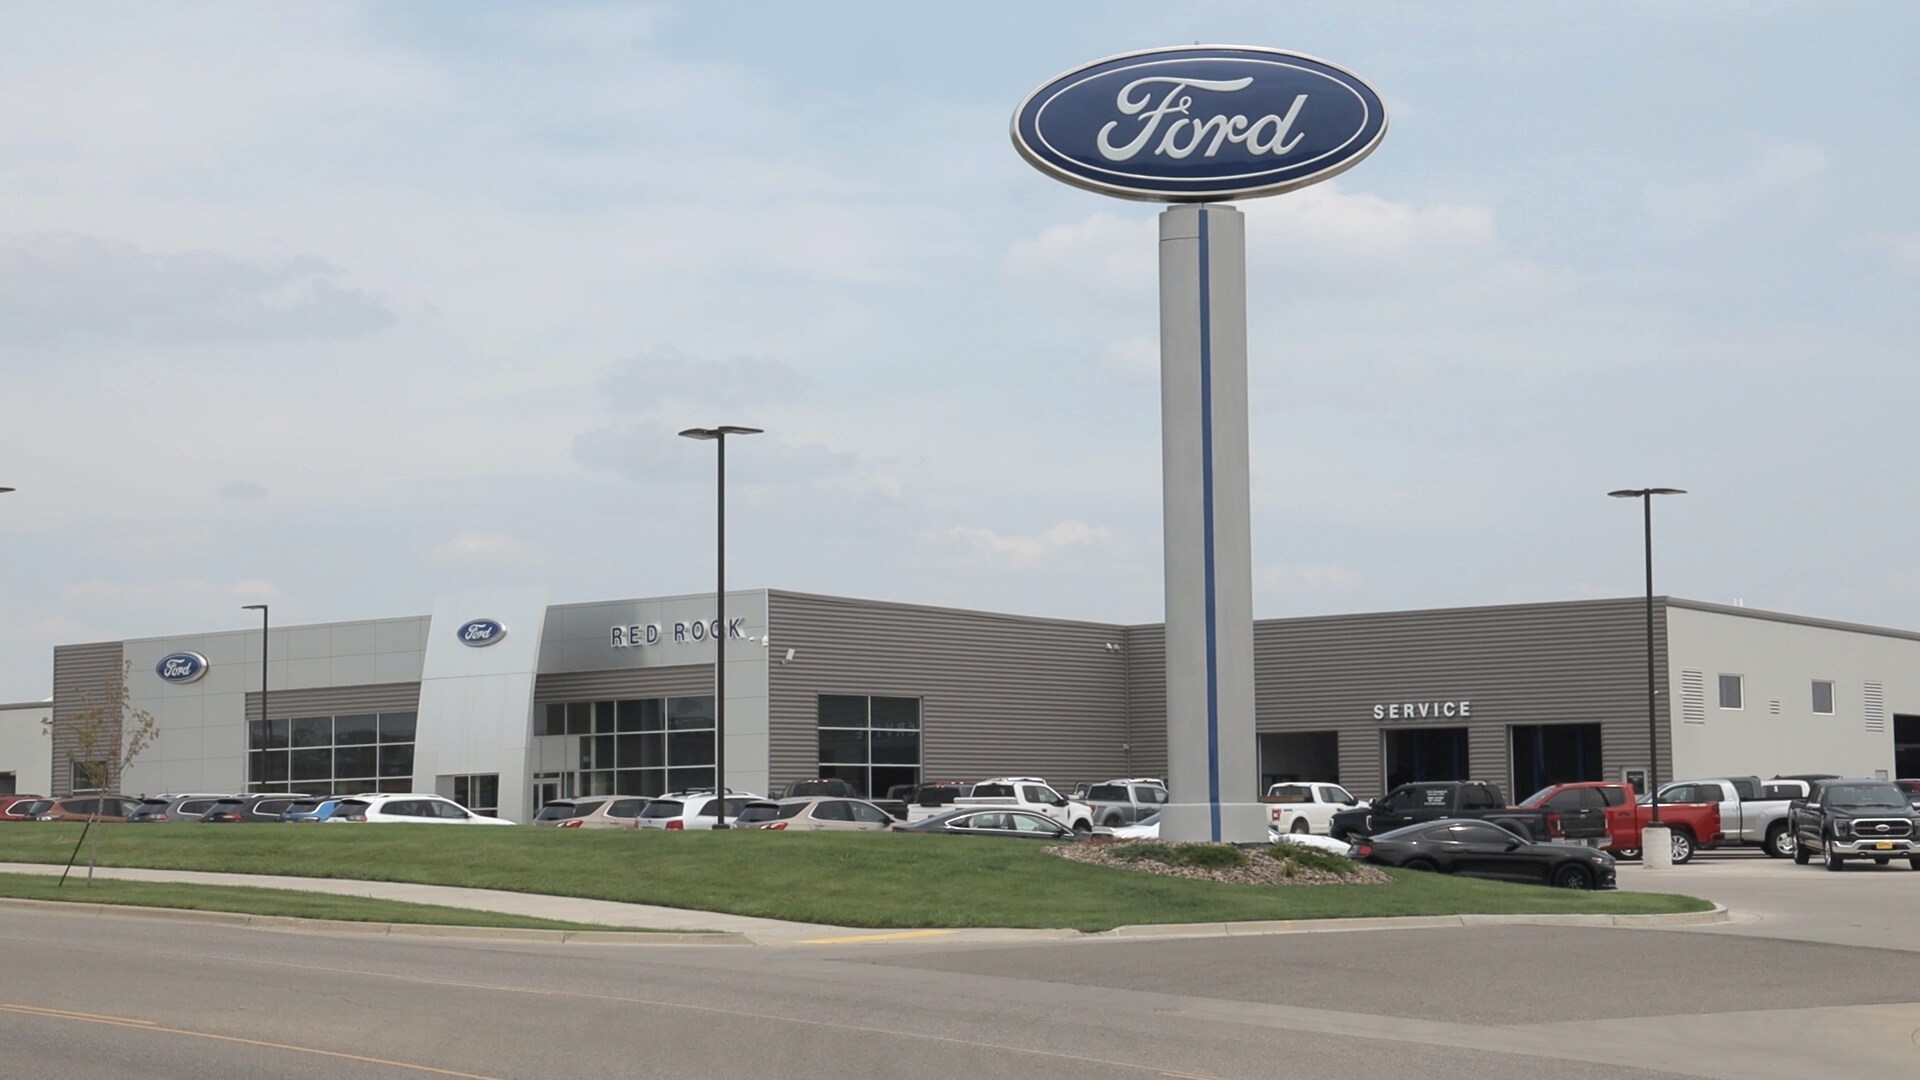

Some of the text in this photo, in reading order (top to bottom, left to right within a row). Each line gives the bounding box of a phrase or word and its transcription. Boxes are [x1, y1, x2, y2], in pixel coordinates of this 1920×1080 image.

[1097, 77, 1308, 161] Ford
[465, 623, 493, 640] Ford
[611, 617, 744, 647] RED ROCK
[163, 658, 192, 677] Ford
[1373, 701, 1470, 719] SERVICE
